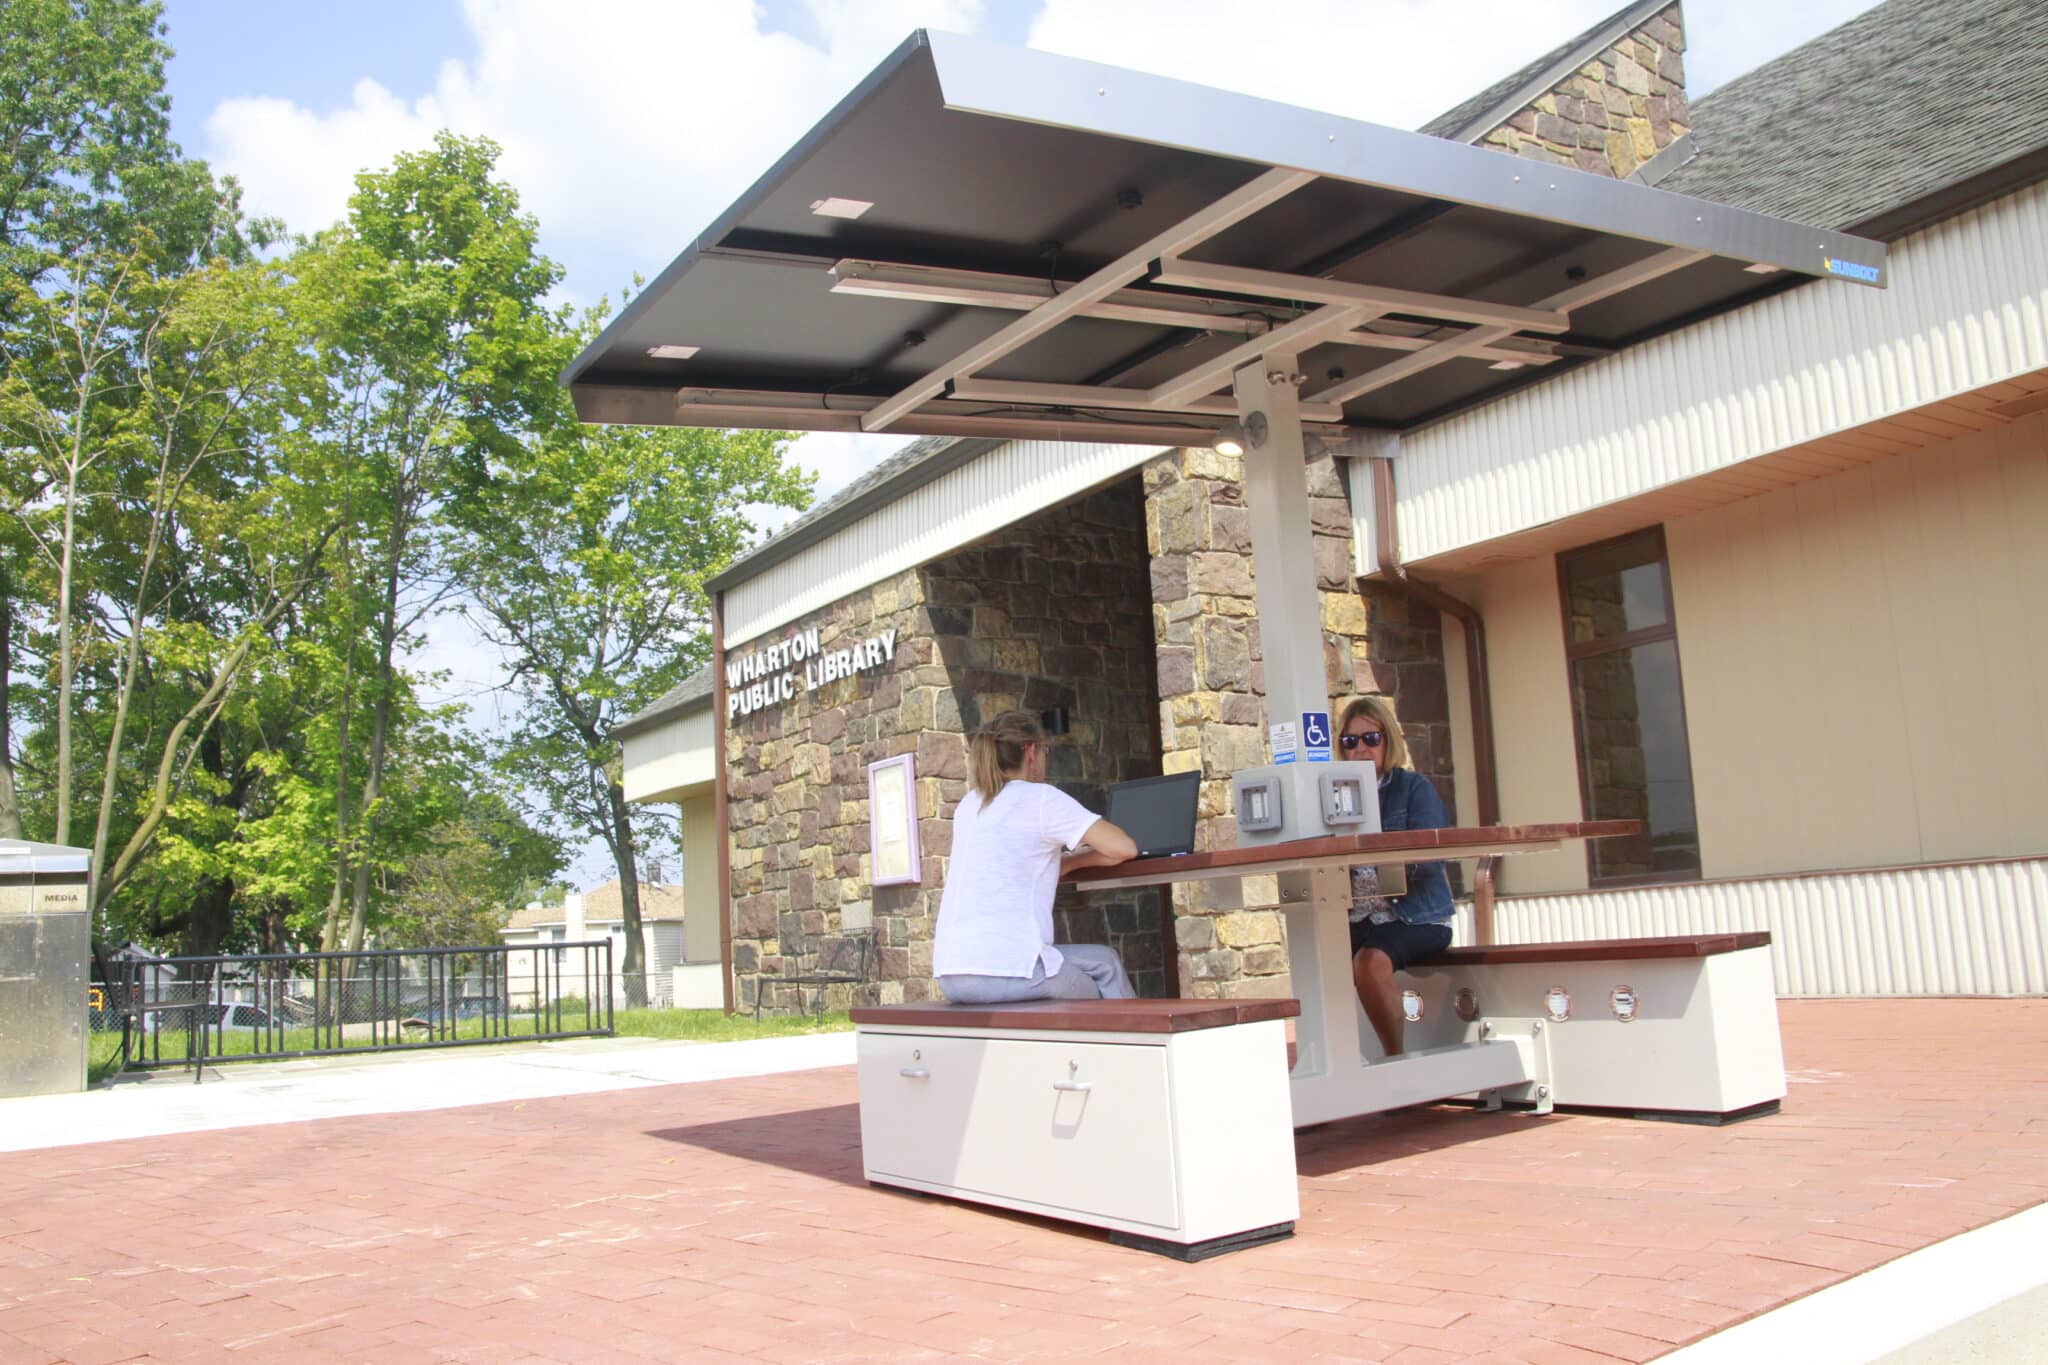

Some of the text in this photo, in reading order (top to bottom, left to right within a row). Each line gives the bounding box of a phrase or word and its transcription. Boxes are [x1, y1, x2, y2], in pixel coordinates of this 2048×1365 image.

[727, 627, 819, 688] WHARTON
[729, 629, 898, 719] PUBLIC LIBRARY
[44, 894, 79, 902] MEDIA
